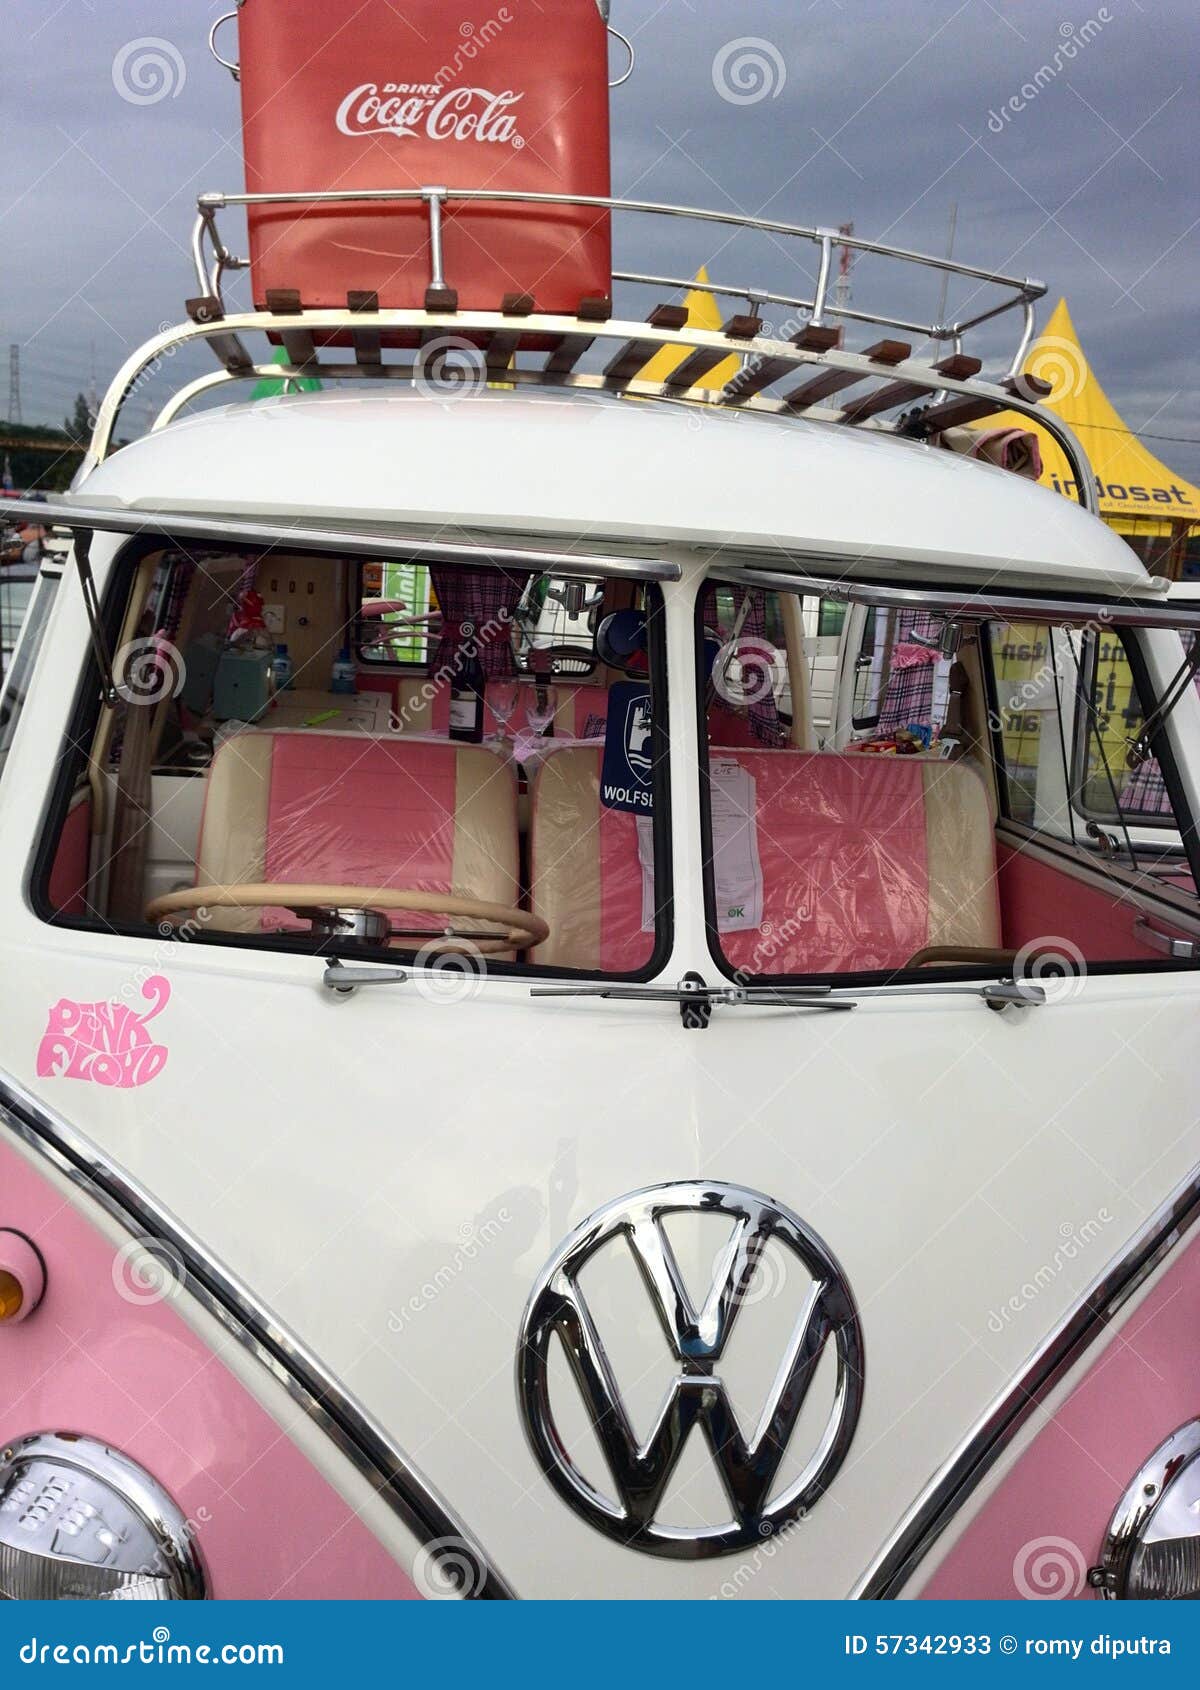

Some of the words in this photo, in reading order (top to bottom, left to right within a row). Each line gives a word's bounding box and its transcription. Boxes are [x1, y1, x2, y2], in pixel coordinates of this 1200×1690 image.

[382, 83, 444, 94] DRINK
[336, 83, 525, 142] Coca-Cola
[728, 908, 745, 918] OK
[36, 1033, 169, 1089] FLOYD
